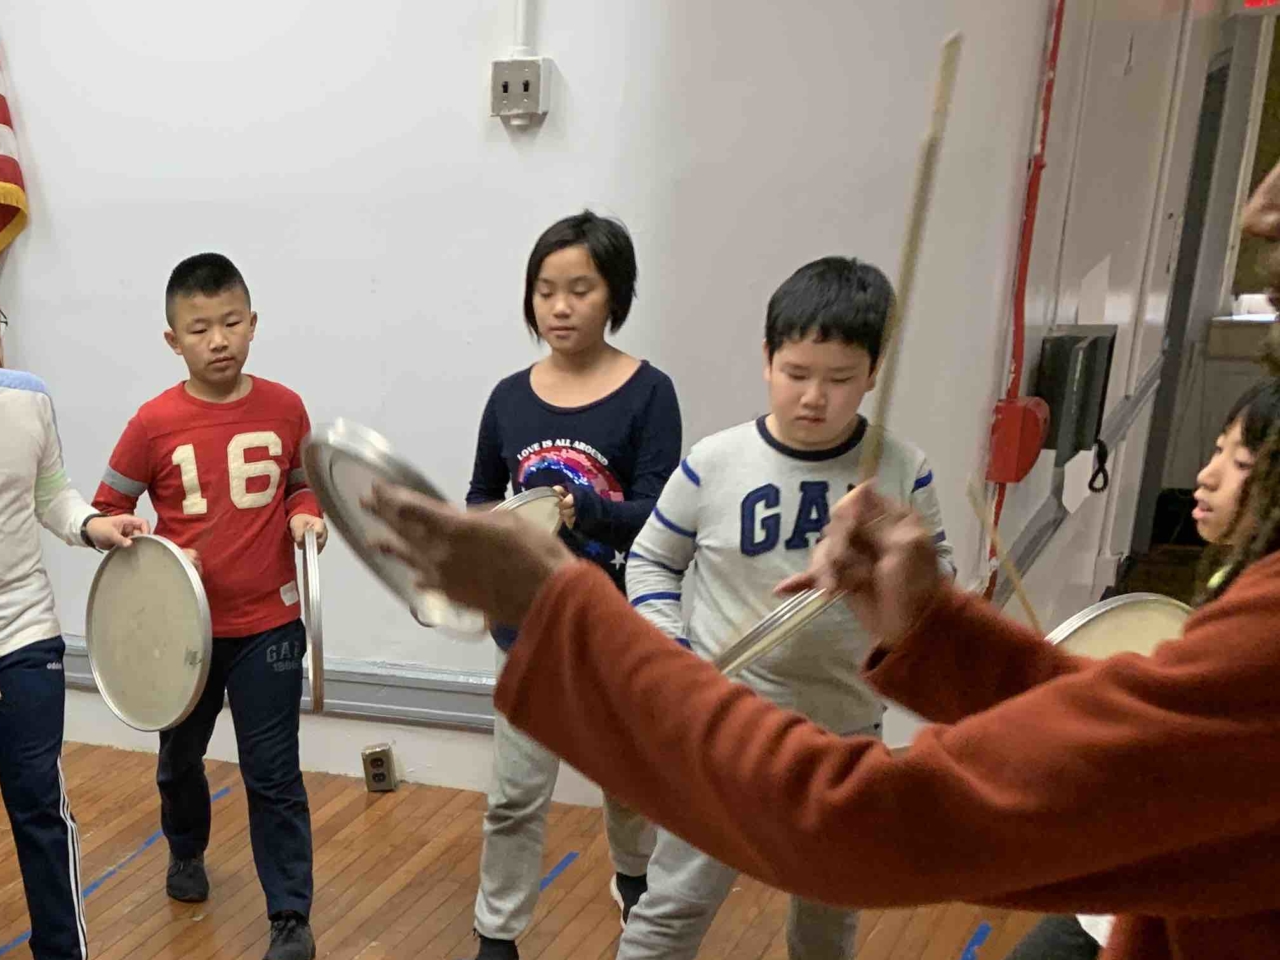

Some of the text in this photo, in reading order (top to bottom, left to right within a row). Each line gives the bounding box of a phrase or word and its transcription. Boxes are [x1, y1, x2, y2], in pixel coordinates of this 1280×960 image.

[517, 438, 609, 466] LOVE IS ALL AROUND
[740, 480, 856, 557] GA
